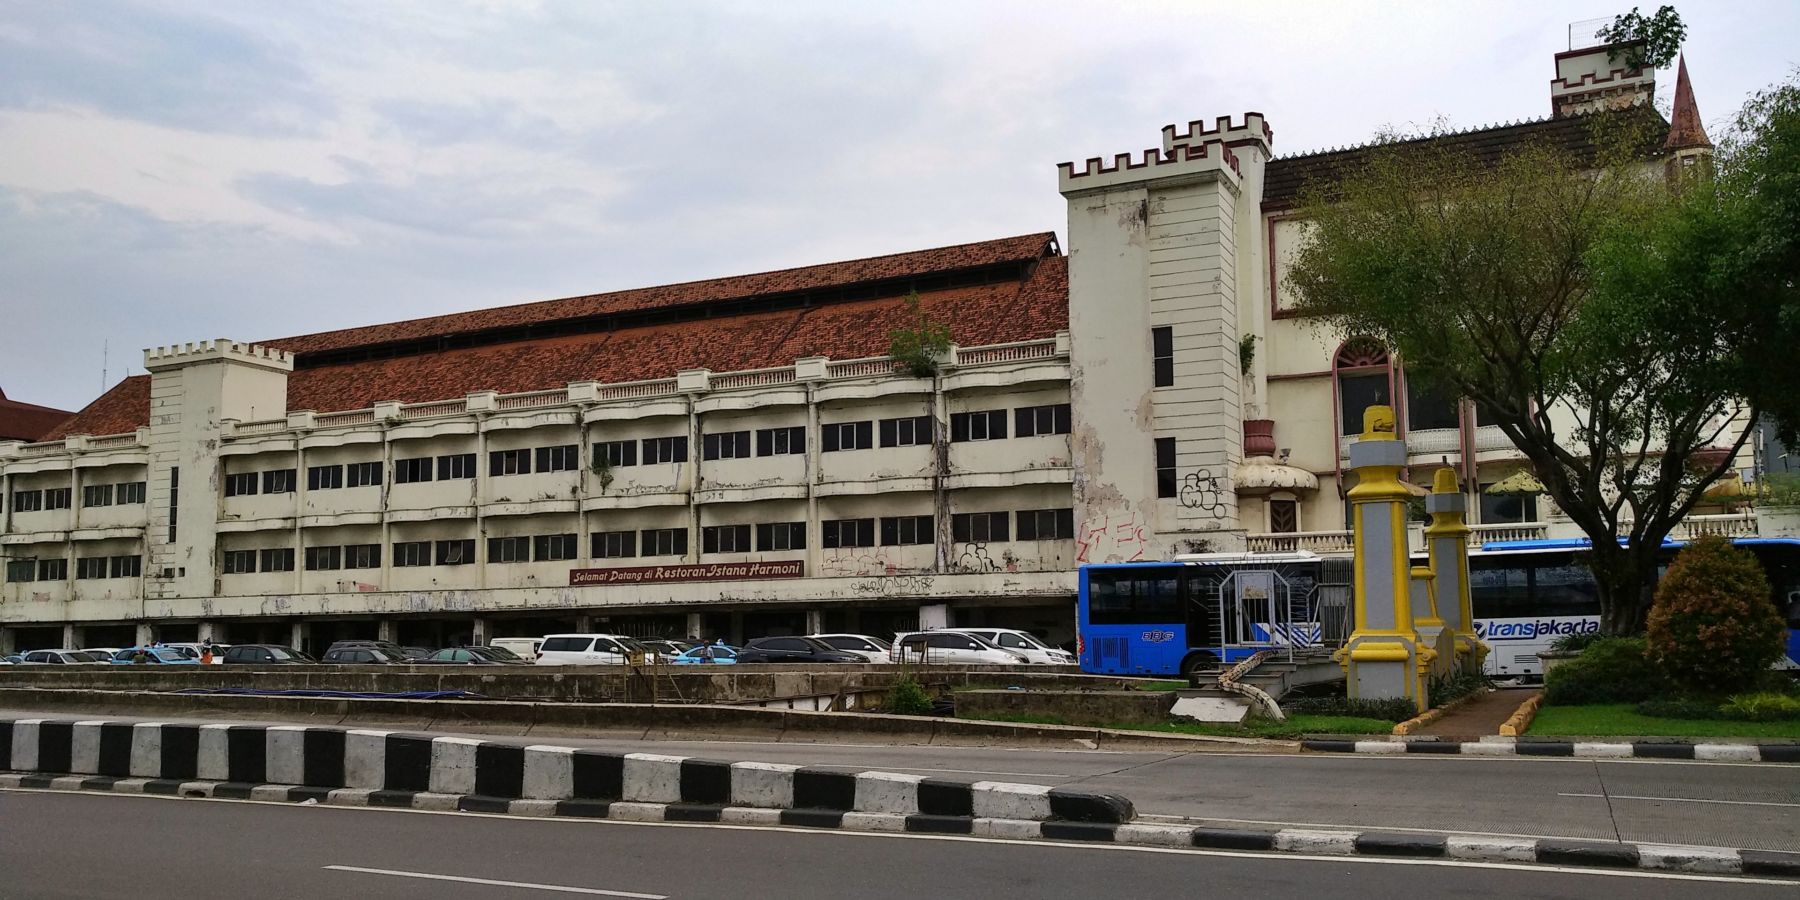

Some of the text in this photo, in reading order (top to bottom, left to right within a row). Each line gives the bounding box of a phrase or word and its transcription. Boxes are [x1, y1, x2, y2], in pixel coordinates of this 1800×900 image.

[573, 562, 801, 583] Selamat Datang di Restoran Istana Harmoni
[1141, 631, 1175, 641] BBG
[1487, 618, 1599, 640] transjakarta
